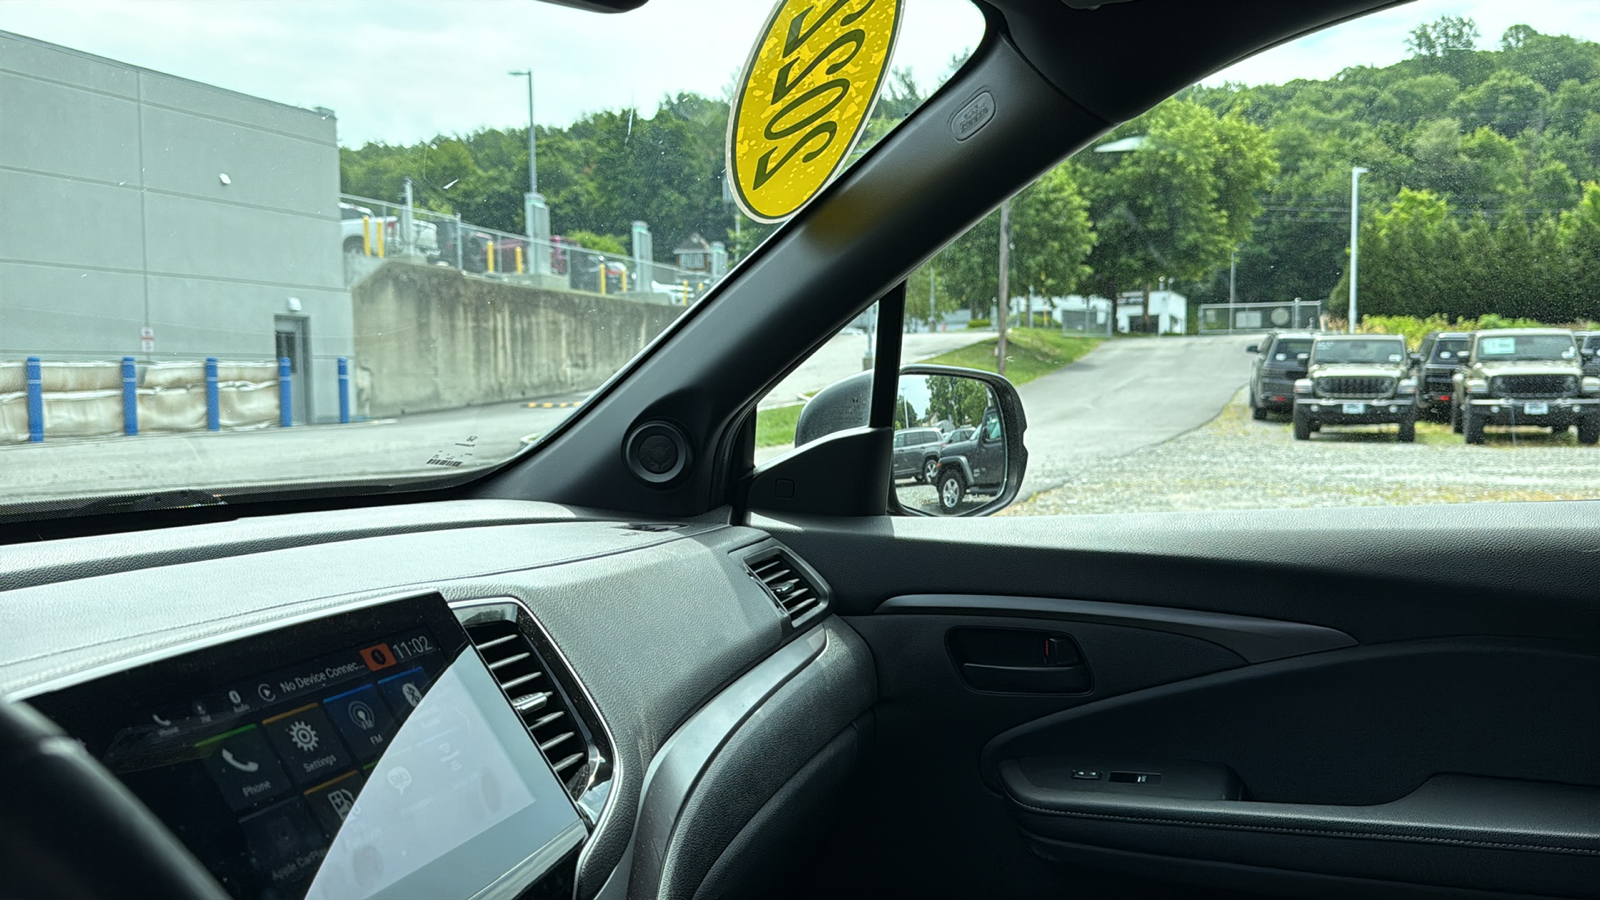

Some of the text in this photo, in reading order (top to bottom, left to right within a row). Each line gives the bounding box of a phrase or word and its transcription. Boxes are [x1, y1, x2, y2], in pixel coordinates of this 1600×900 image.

[392, 635, 433, 659] 11:02
[280, 681, 296, 694] No
[294, 671, 328, 689] Device
[369, 732, 384, 746] FM
[302, 754, 338, 773] Settings
[242, 780, 272, 798] Phone
